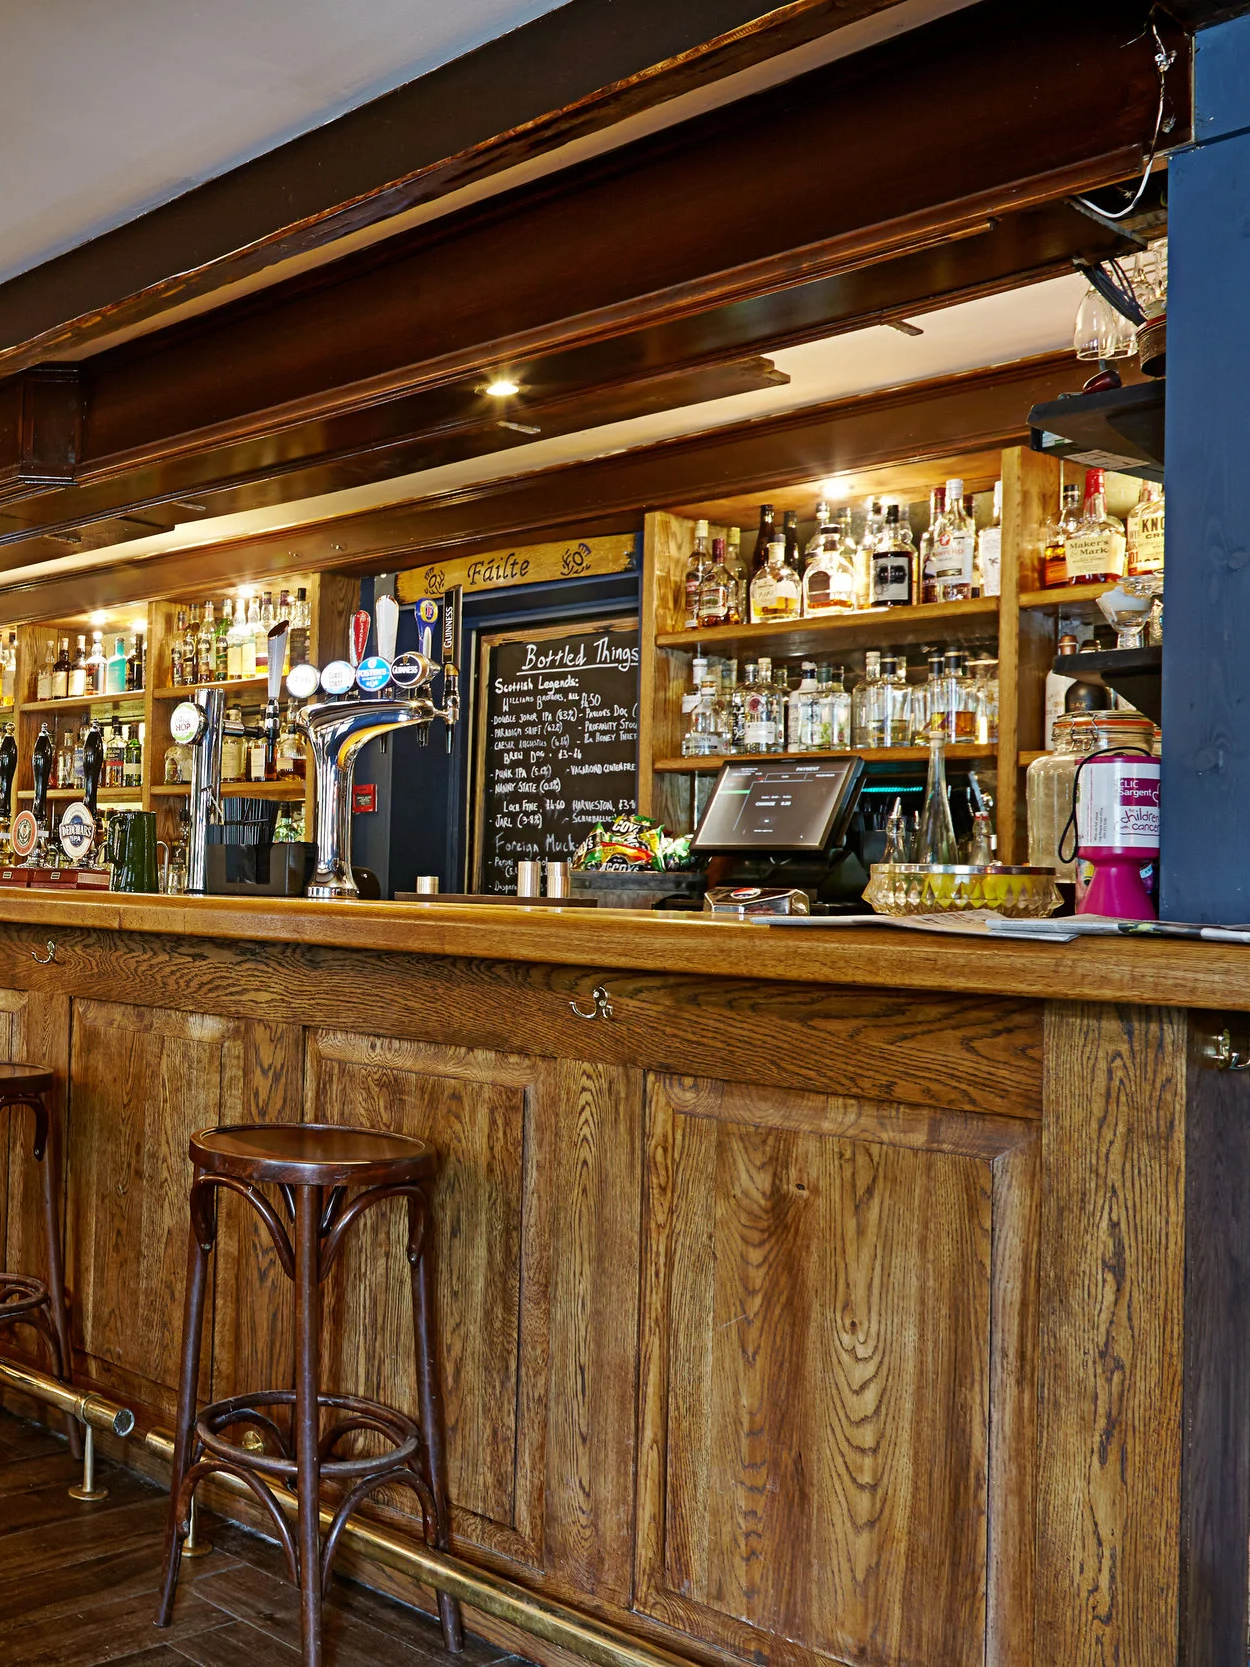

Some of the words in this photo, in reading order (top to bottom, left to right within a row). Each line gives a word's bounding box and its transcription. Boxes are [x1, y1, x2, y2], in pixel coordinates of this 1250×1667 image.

[1070, 540, 1109, 549] Maker's
[1079, 547, 1109, 556] Mark
[467, 552, 530, 585] Fáilte
[443, 606, 454, 648] GUINNESS
[521, 643, 587, 670] Bottled
[593, 636, 639, 671] Things
[392, 665, 419, 674] GUINNESS
[494, 678, 533, 694] Scottish
[542, 711, 553, 722] IPA
[175, 722, 191, 732] HOP
[620, 718, 638, 729] STOU
[503, 751, 523, 764] BREW
[494, 768, 513, 780] PUNK
[514, 766, 528, 779] IPA
[570, 763, 603, 776] VAGABOND
[623, 762, 636, 772] FRE
[517, 781, 538, 793] STATE
[1119, 780, 1139, 788] CLIC
[1119, 789, 1152, 798] Sargent
[495, 814, 513, 828] JARL
[495, 831, 539, 858] Foreign
